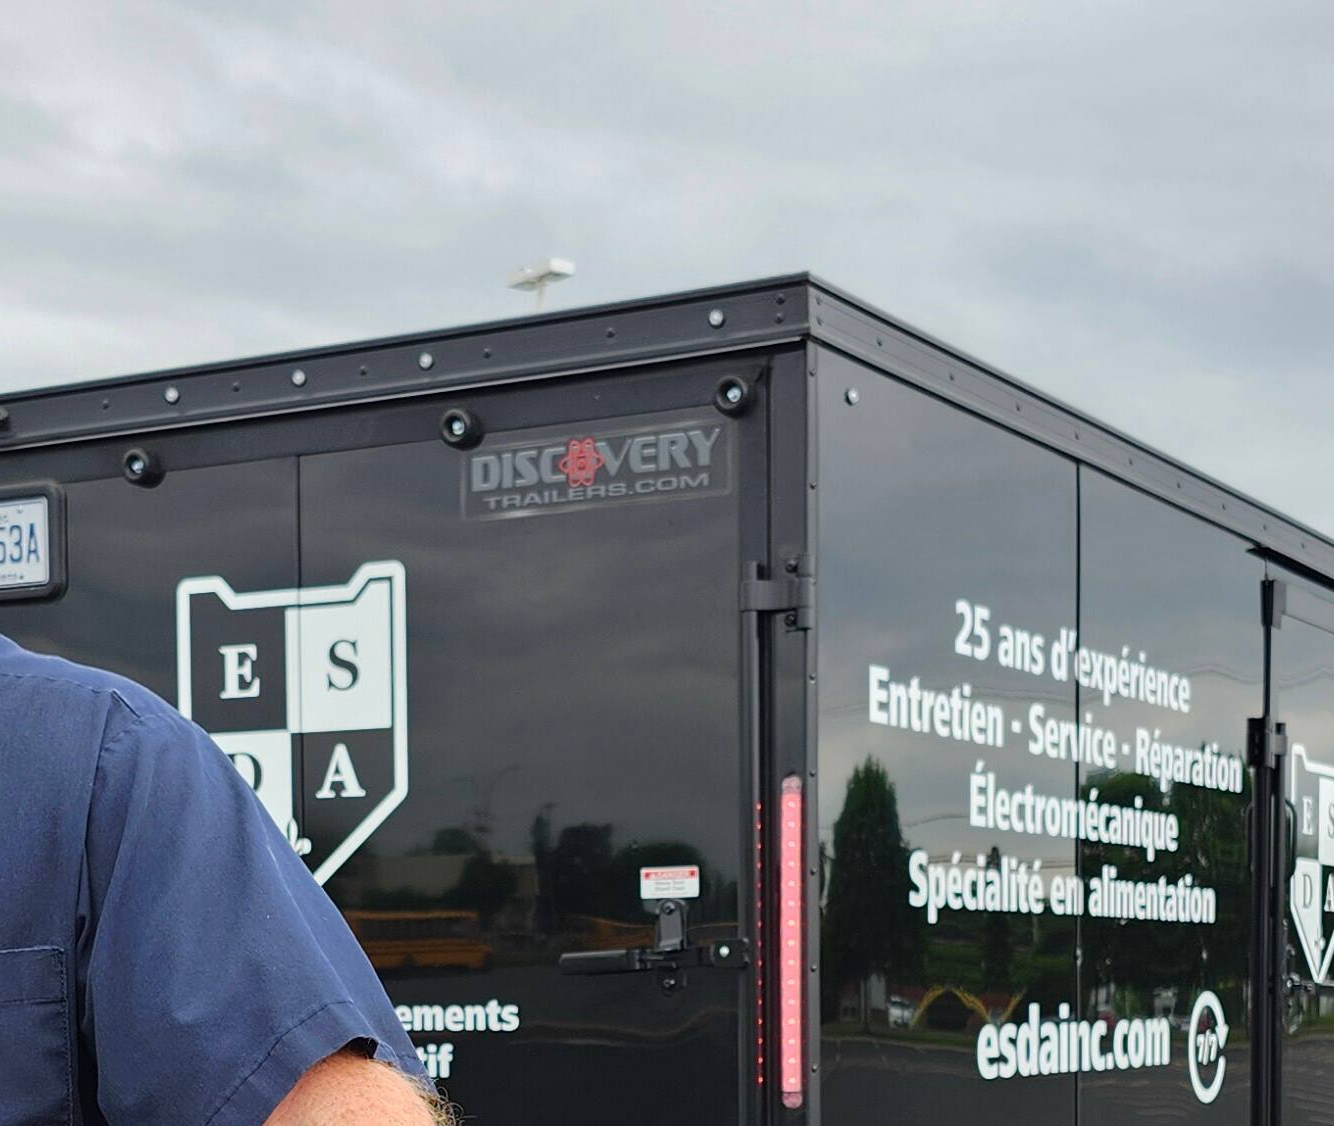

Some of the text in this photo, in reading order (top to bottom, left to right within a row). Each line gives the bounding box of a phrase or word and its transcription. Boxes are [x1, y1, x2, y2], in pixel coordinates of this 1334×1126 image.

[471, 428, 721, 492] DISCOVERY
[483, 473, 709, 510] TRAILERS.COM
[218, 639, 359, 700] E S
[954, 599, 1191, 713] 25 ans d'expérience
[869, 664, 1004, 748] Entretien
[1028, 702, 1116, 770] Service
[1136, 727, 1244, 794] Réparation
[315, 743, 367, 799] A
[969, 760, 1179, 862] Électromécanique
[1302, 796, 1314, 836] E
[908, 850, 1217, 925] Spécialité en alimentation
[1302, 873, 1313, 909] D
[398, 999, 520, 1032] ements
[977, 1002, 1171, 1080] esdainc.com
[1196, 1028, 1218, 1066] 7/7
